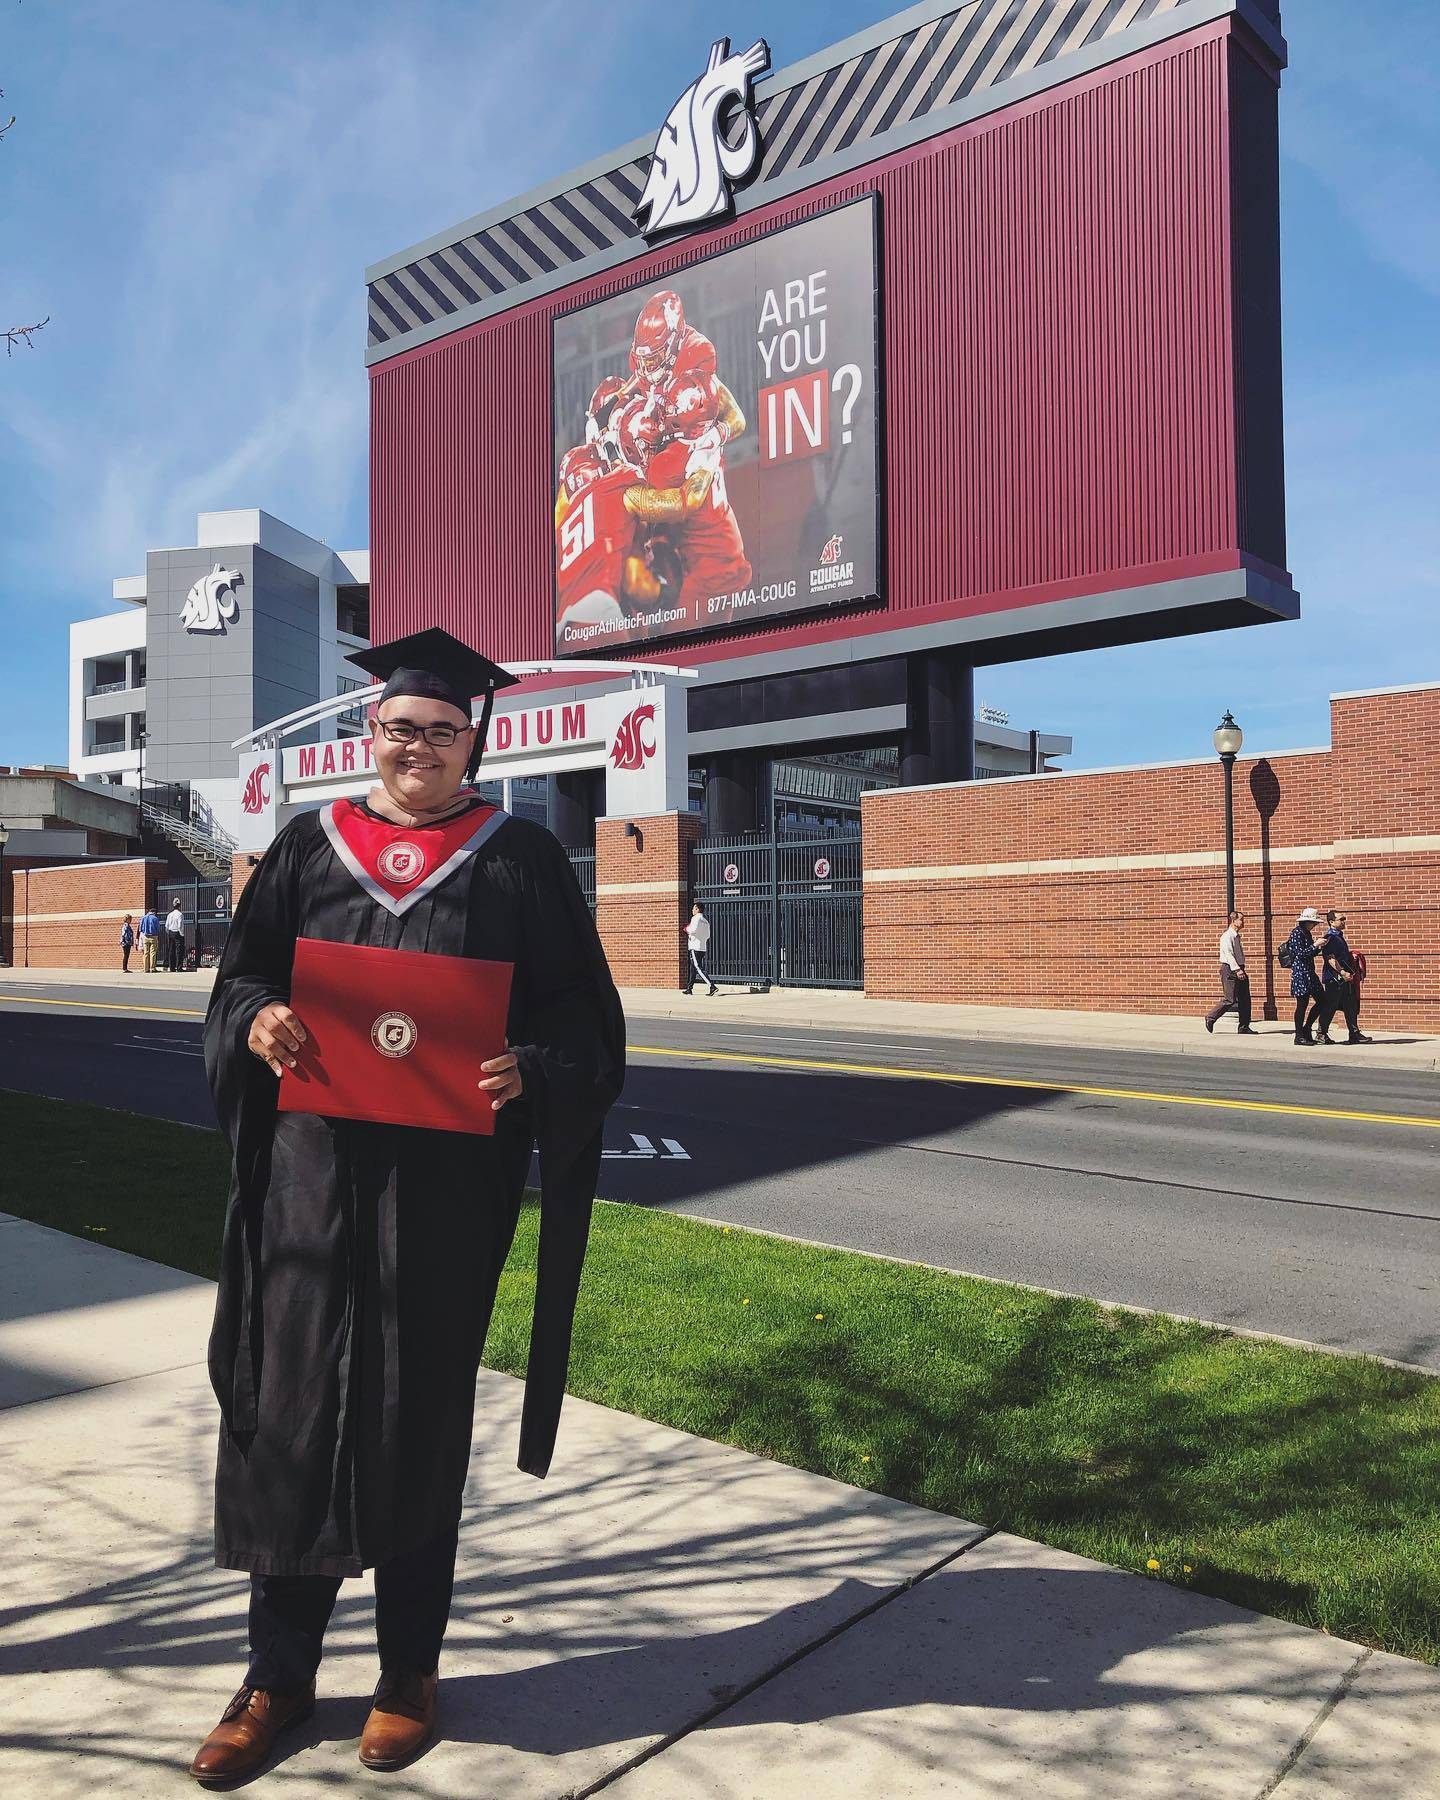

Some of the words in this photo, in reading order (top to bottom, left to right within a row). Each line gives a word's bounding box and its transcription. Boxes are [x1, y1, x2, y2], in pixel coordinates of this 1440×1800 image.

[757, 269, 828, 334] ARE
[757, 319, 826, 379] YOU
[767, 363, 863, 460] IN?
[560, 492, 595, 572] 51
[809, 562, 854, 587] COUGAR
[809, 582, 837, 594] ATHLETIC
[837, 579, 854, 588] FUND
[564, 606, 687, 642] CougarAthleticFund.com
[707, 580, 797, 614] 877-IMA-COUG
[299, 737, 373, 778] MART
[475, 703, 586, 753] DIUM
